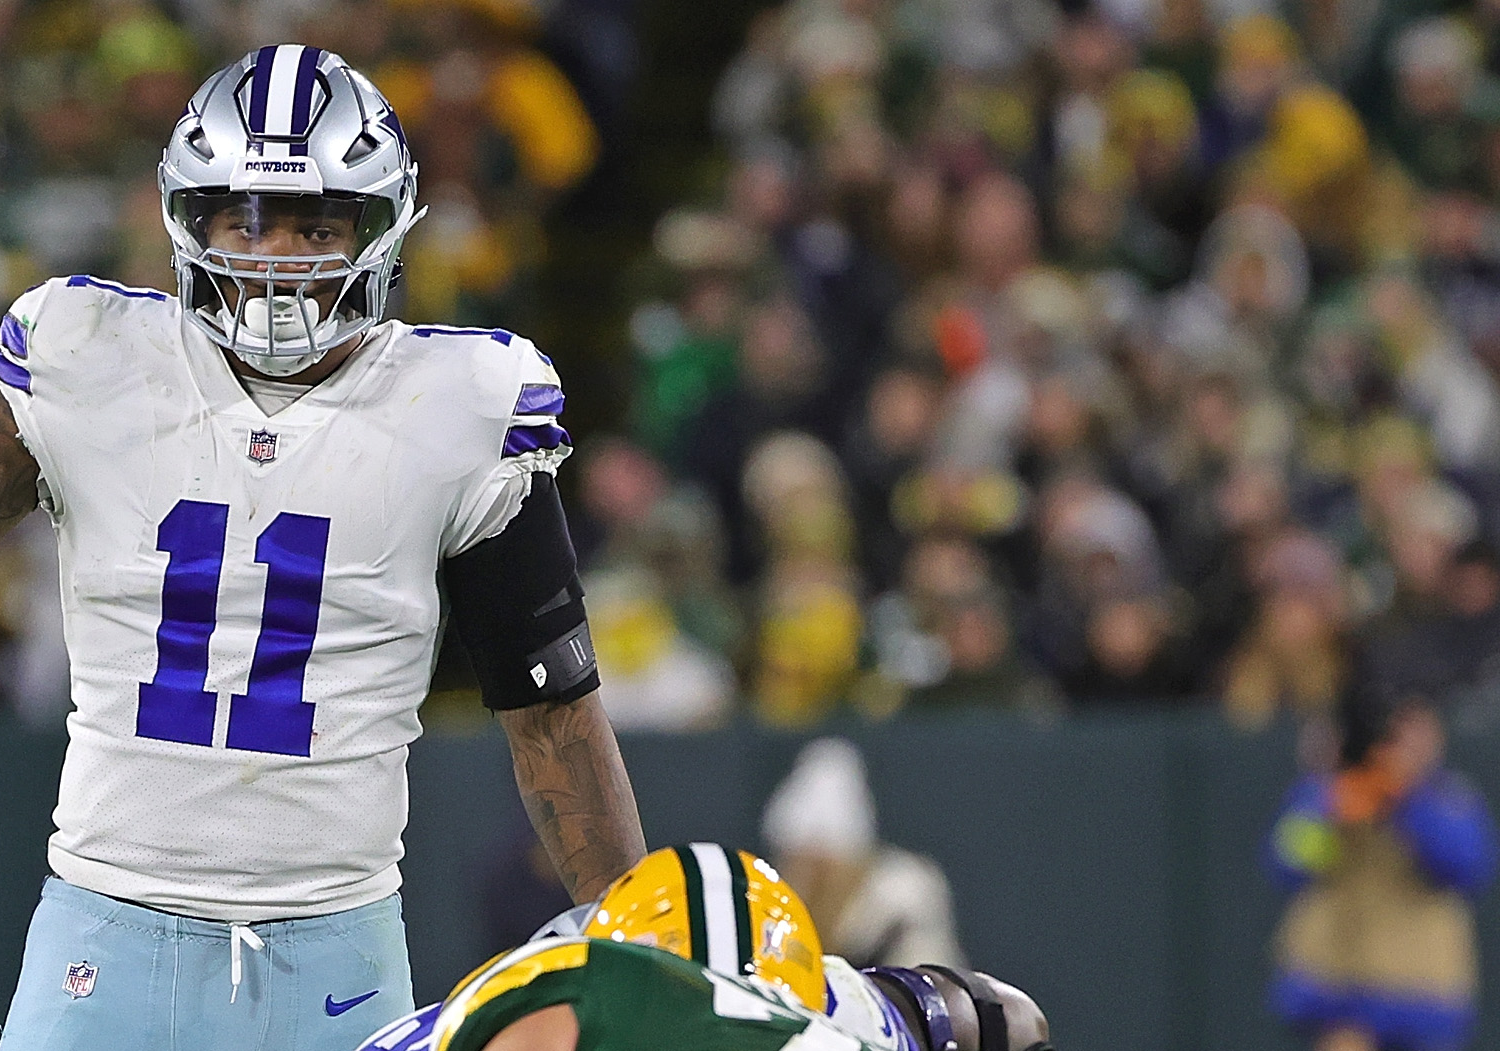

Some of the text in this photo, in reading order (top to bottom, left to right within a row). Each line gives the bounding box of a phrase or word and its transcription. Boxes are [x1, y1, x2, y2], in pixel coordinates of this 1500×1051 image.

[245, 161, 306, 173] COWBOYS
[251, 443, 274, 459] NFL
[135, 499, 331, 758] 11
[67, 976, 88, 992] NFL
